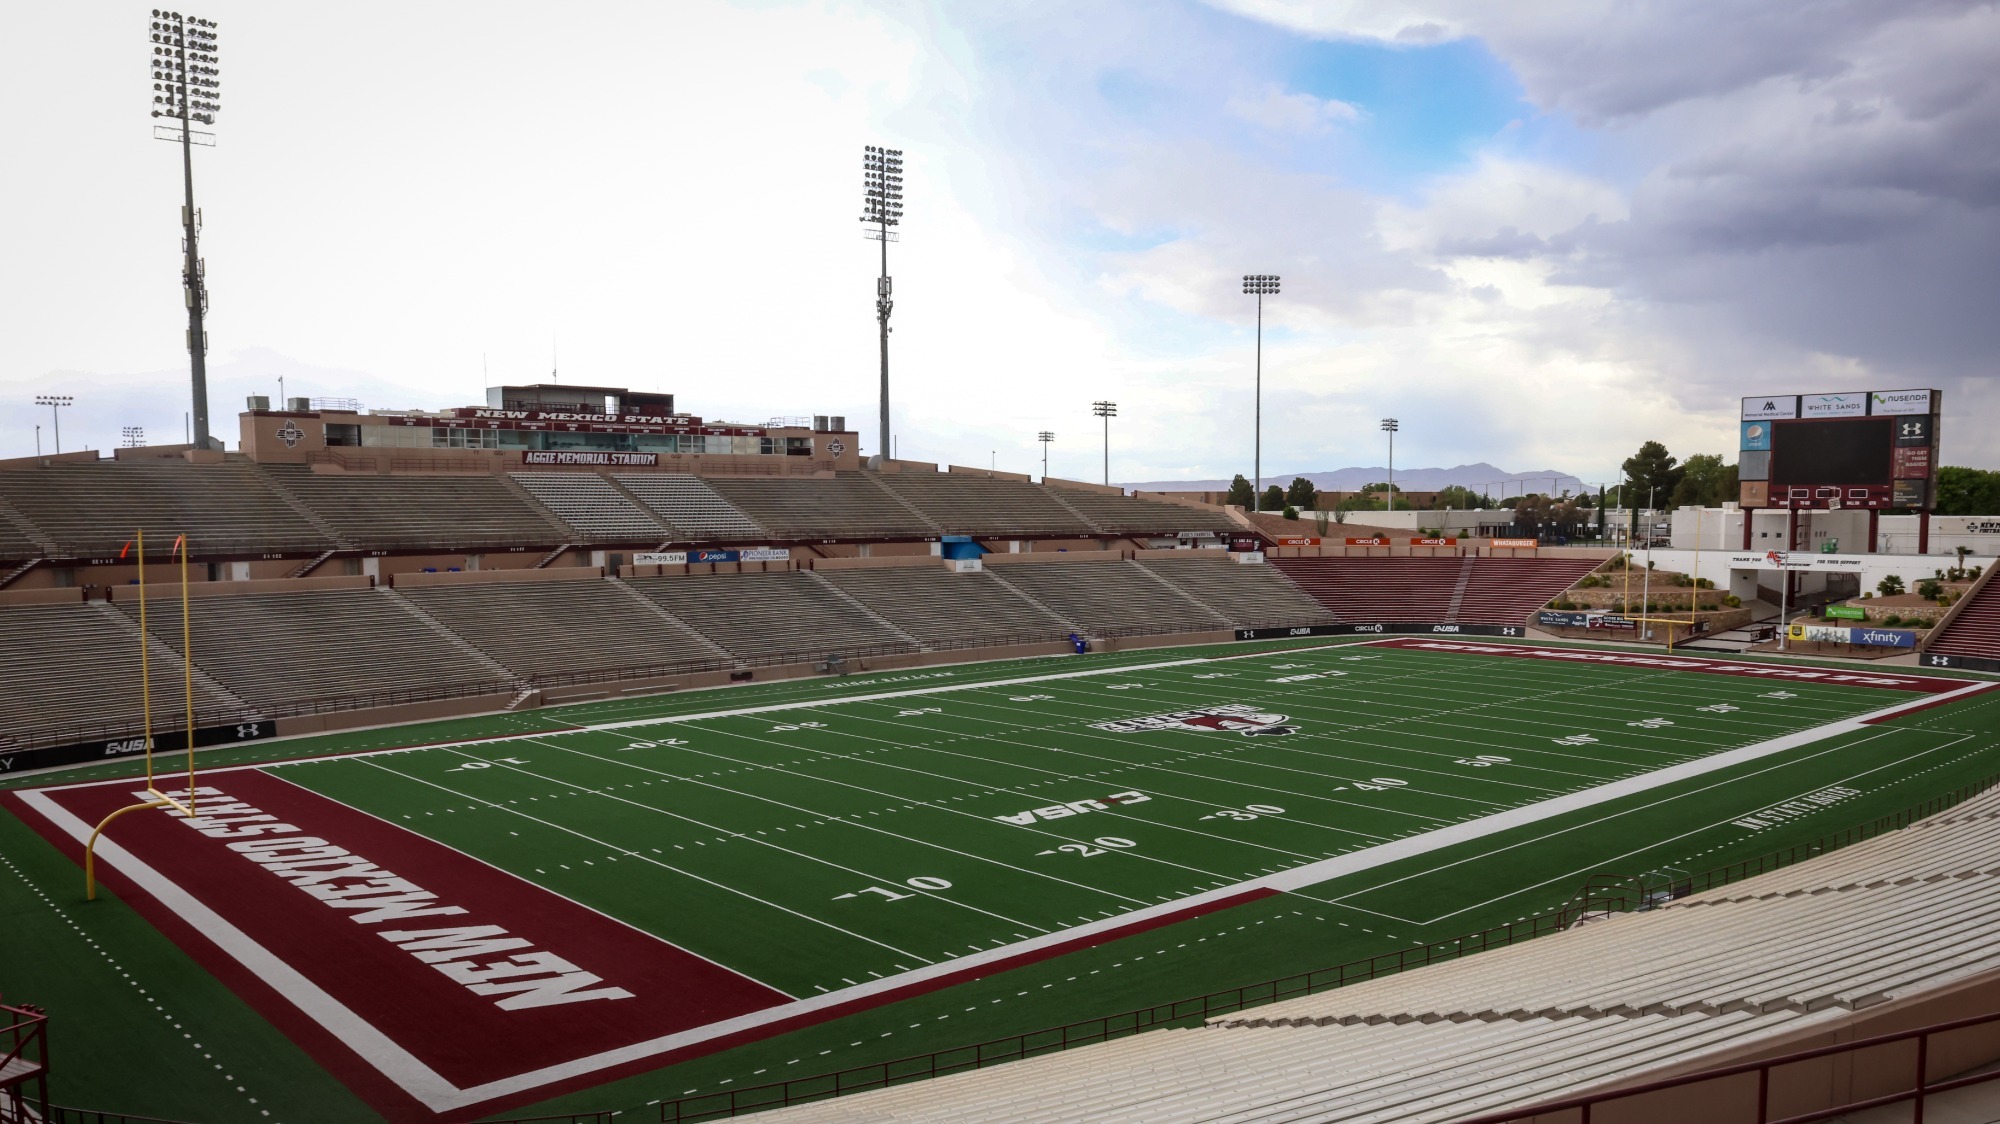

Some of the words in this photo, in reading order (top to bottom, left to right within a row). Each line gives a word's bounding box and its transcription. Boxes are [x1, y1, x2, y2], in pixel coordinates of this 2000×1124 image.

[475, 409, 529, 419] NEW
[537, 411, 618, 422] MEXICO
[624, 414, 690, 425] STATE
[525, 452, 556, 464] AGGIE
[556, 453, 610, 465] MEMORIAL
[611, 454, 656, 465] STADIUM
[708, 552, 727, 561] pepsi
[1862, 631, 1902, 645] xfinity
[629, 737, 690, 751] 20
[461, 756, 531, 770] 10
[1454, 755, 1512, 768] 50
[1353, 777, 1409, 794] 40
[1755, 801, 1819, 821] STATE
[1801, 786, 1861, 806] AGGIES
[131, 786, 303, 839] STATE
[1218, 804, 1286, 822] 30
[1058, 836, 1138, 858] 20
[225, 836, 470, 924] MEXICO
[858, 875, 953, 903] 10
[376, 924, 637, 1012] NEW
